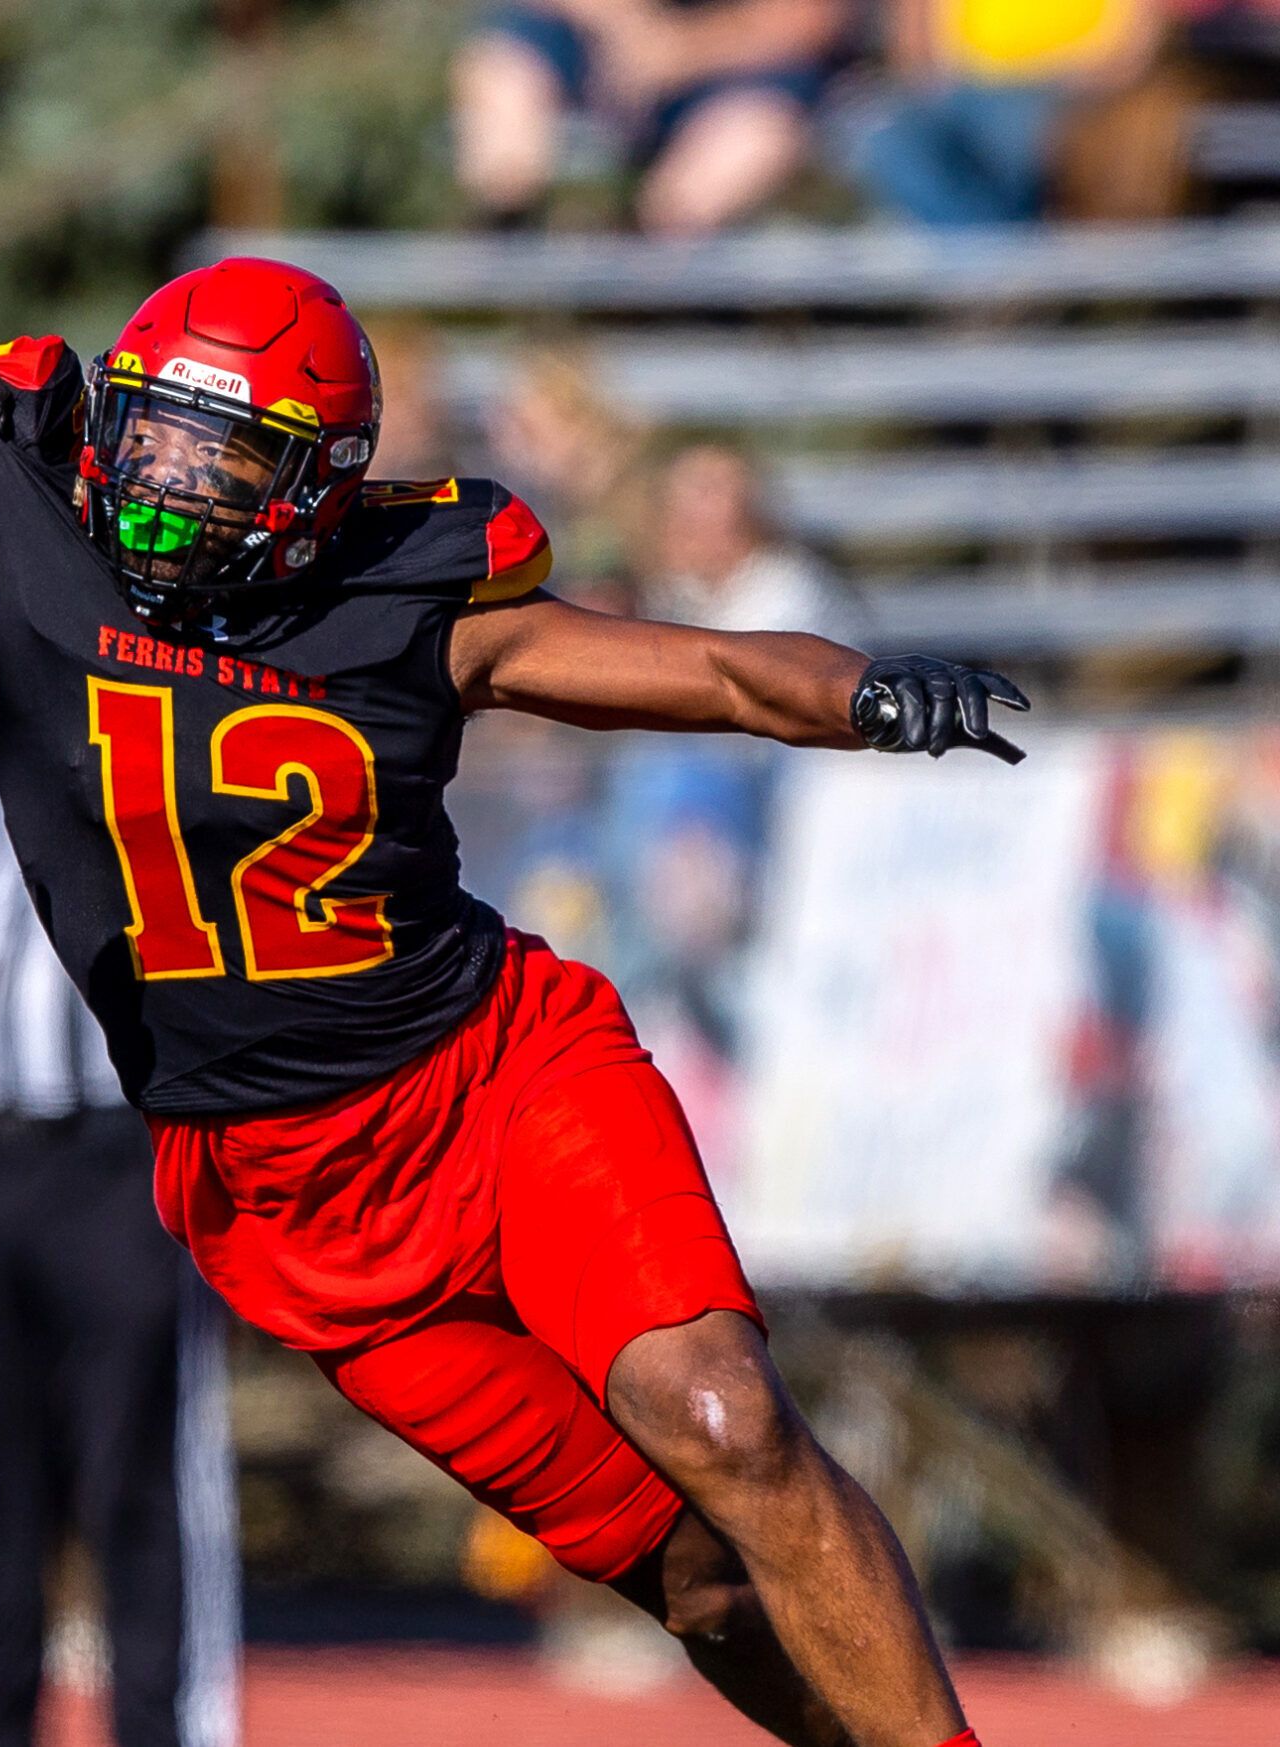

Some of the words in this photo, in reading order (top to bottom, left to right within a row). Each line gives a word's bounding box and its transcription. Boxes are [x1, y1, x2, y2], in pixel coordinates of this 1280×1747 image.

[98, 625, 204, 677] FERRIS
[217, 656, 327, 700] STATE
[86, 674, 394, 981] 12
